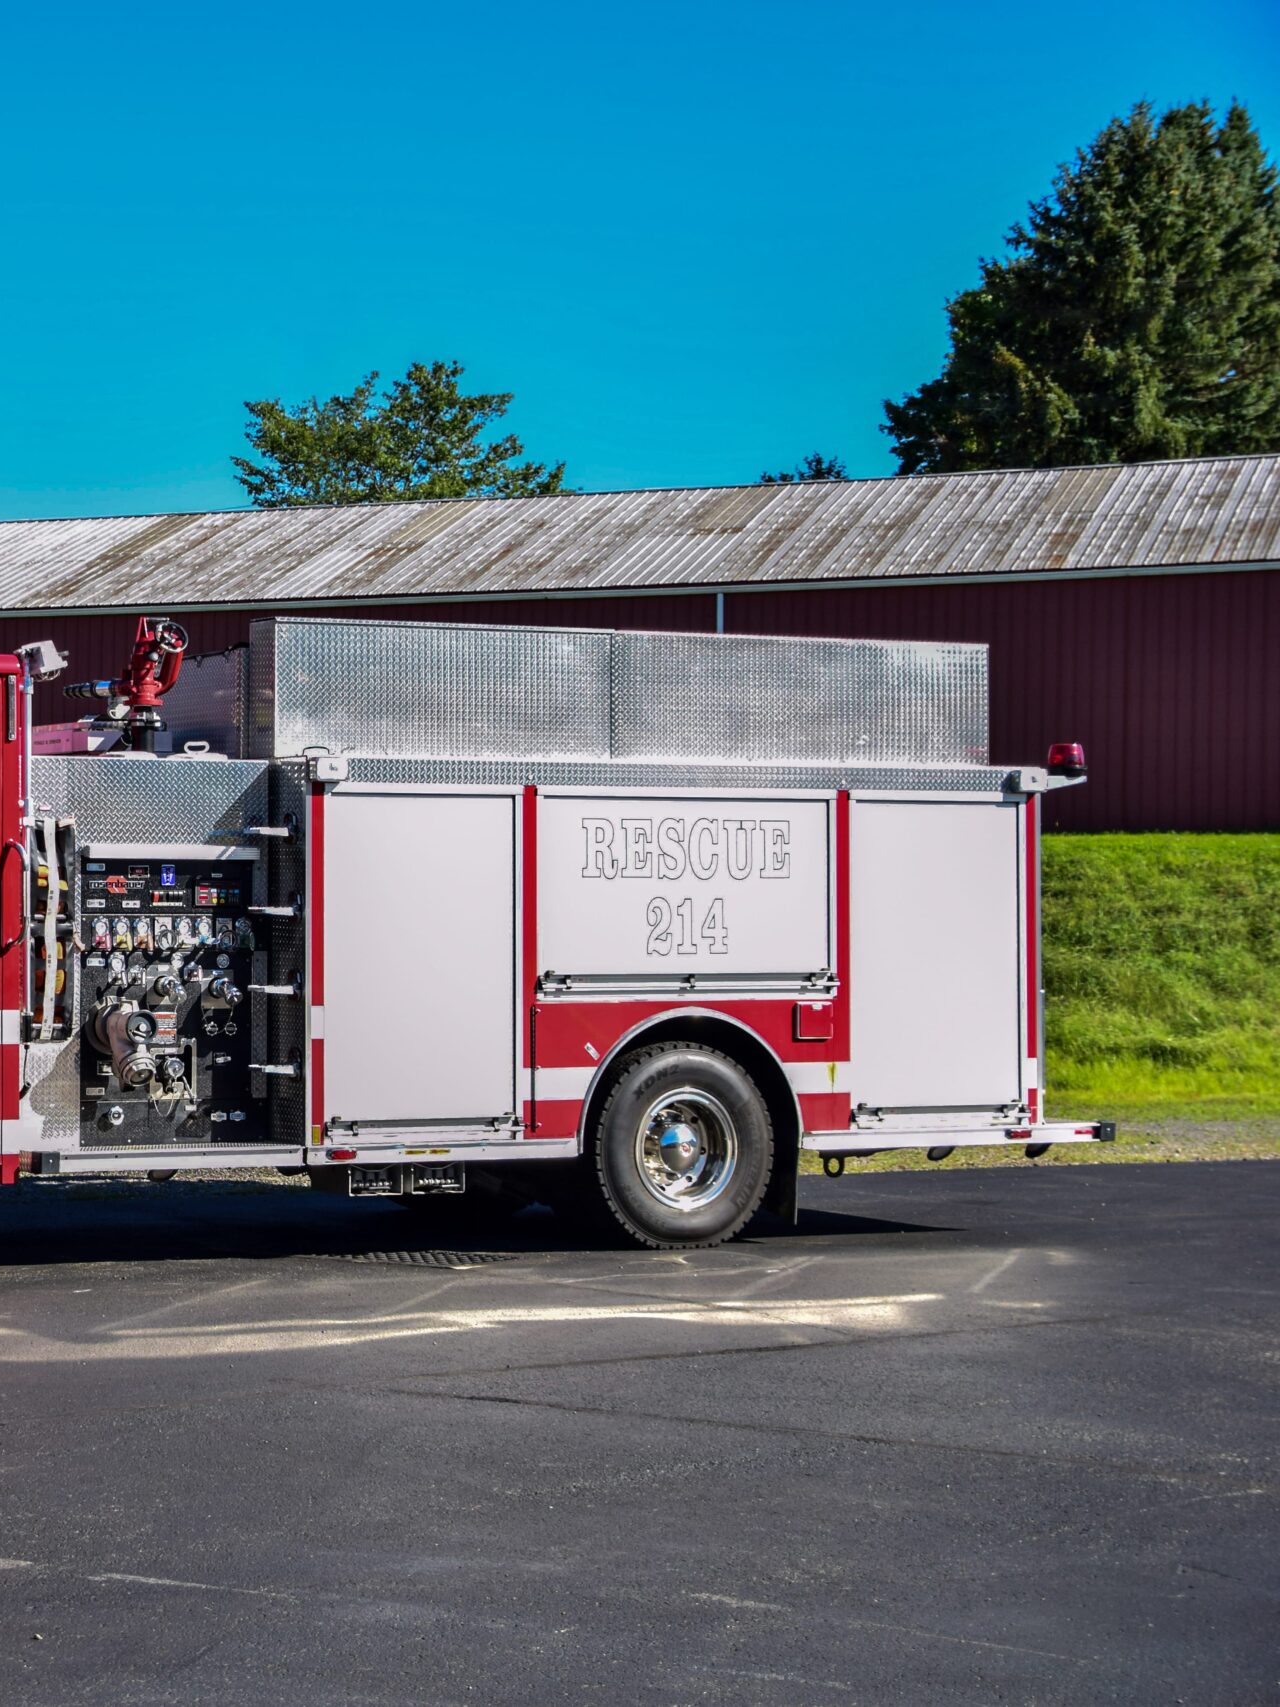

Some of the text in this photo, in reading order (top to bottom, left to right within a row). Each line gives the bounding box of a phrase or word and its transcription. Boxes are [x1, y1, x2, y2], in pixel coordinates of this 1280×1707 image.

[581, 817, 791, 881] RESCUE
[89, 880, 145, 890] rosenbauer
[645, 896, 729, 957] 214
